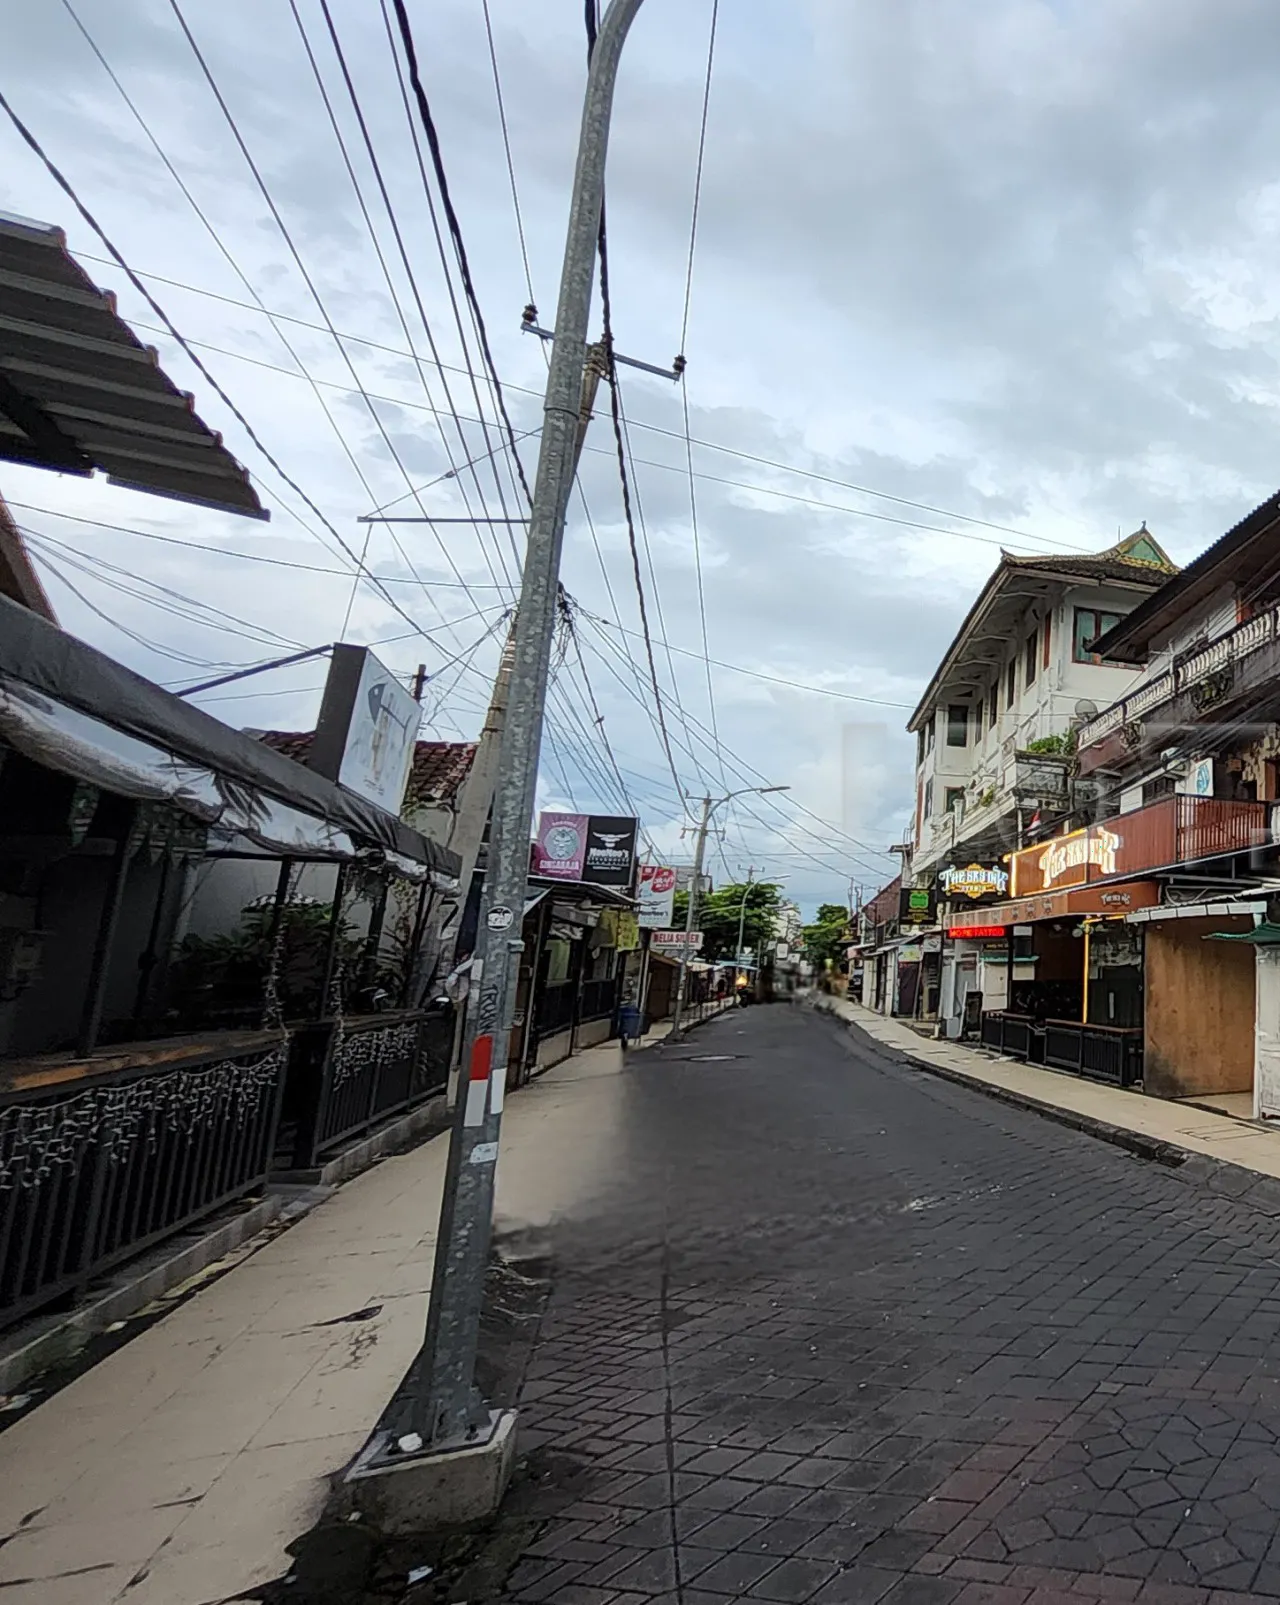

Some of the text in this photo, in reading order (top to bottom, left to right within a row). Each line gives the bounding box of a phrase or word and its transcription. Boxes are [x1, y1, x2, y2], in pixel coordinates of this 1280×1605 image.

[938, 864, 965, 891] THE
[966, 870, 986, 882] SKY
[675, 933, 699, 944] SILER
